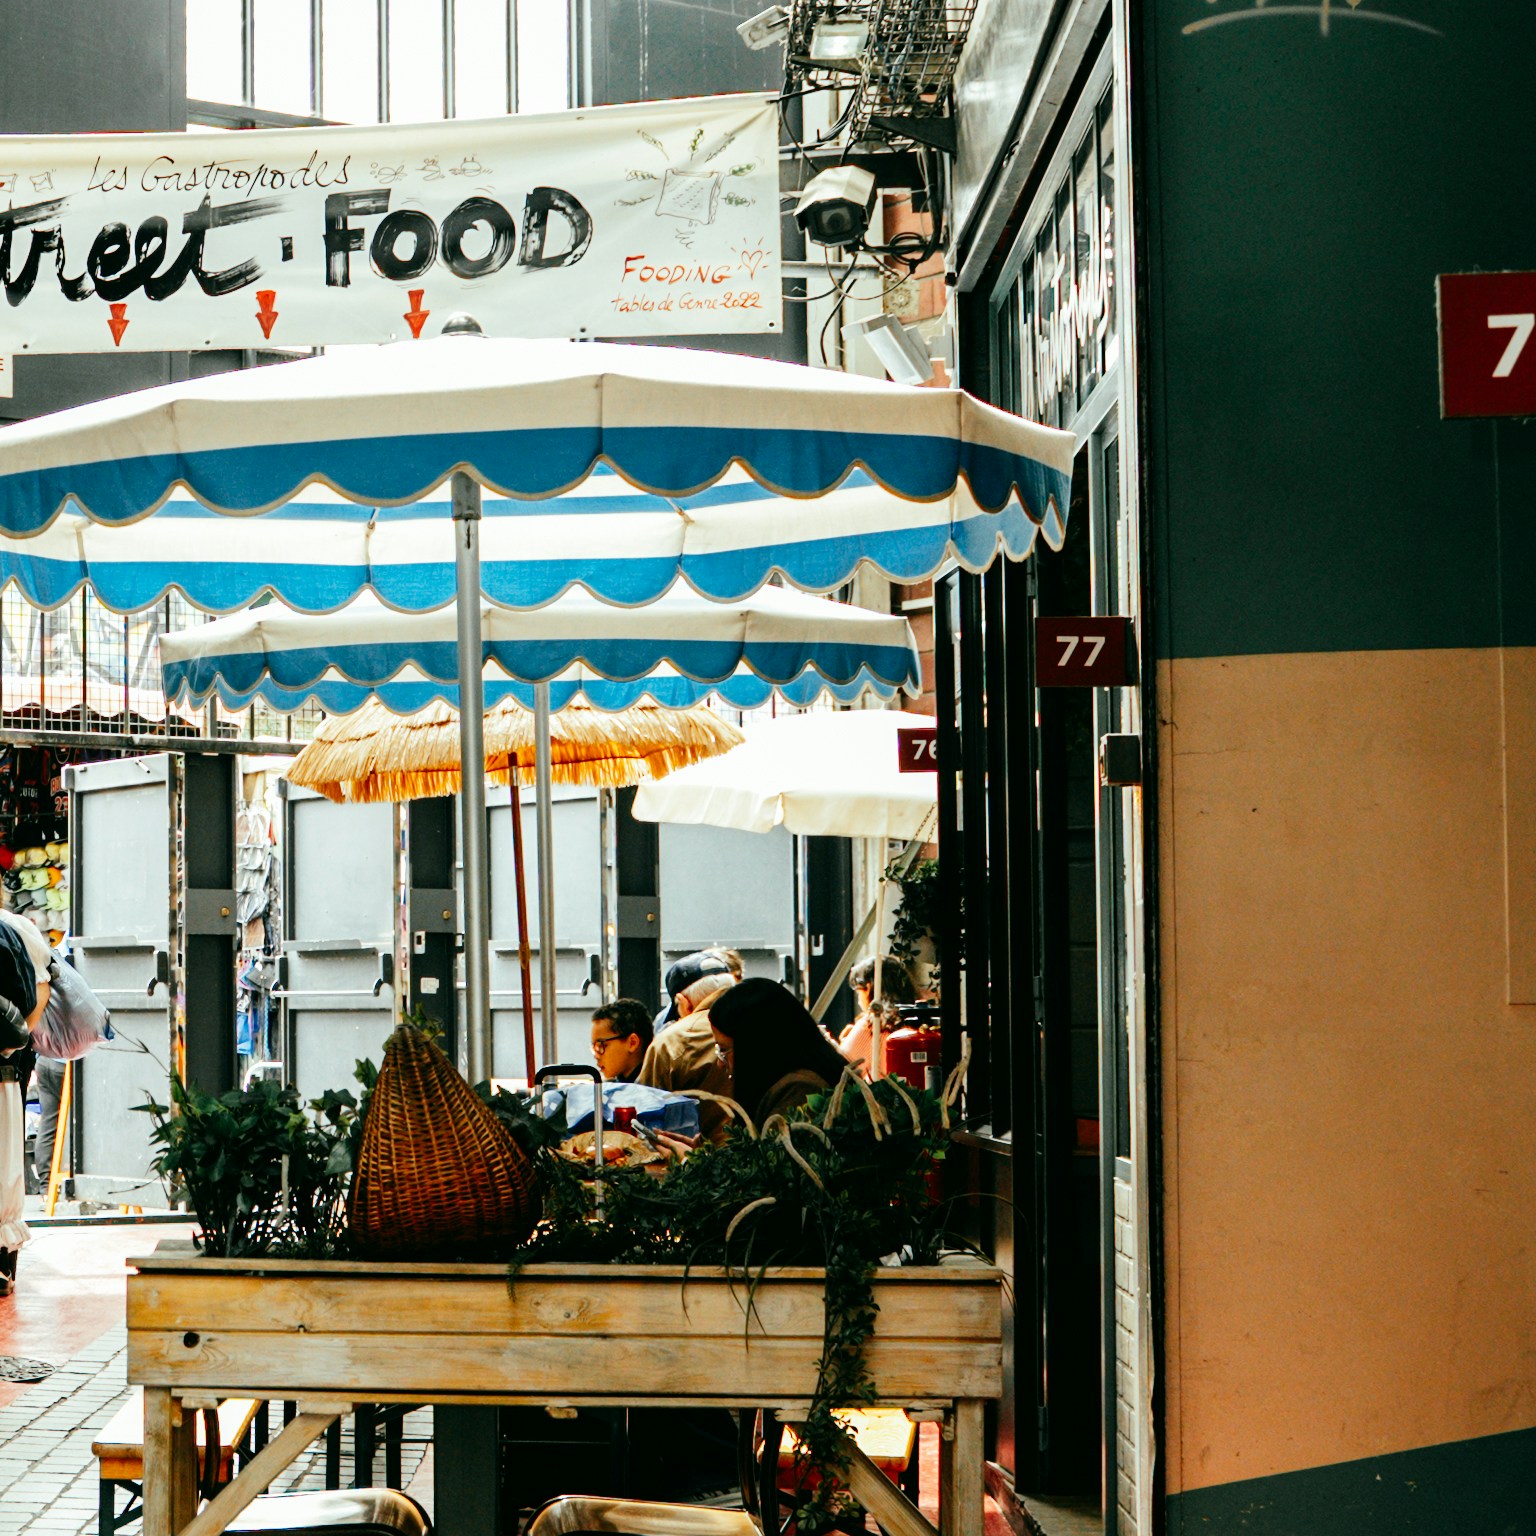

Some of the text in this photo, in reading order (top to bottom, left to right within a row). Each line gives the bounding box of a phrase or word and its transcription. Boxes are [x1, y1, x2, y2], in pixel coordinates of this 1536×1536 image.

[88, 150, 353, 197] Les Gastropodes
[323, 186, 593, 287] FOOD
[657, 293, 673, 312] de
[718, 291, 764, 309] 2022
[1056, 636, 1106, 667] 77
